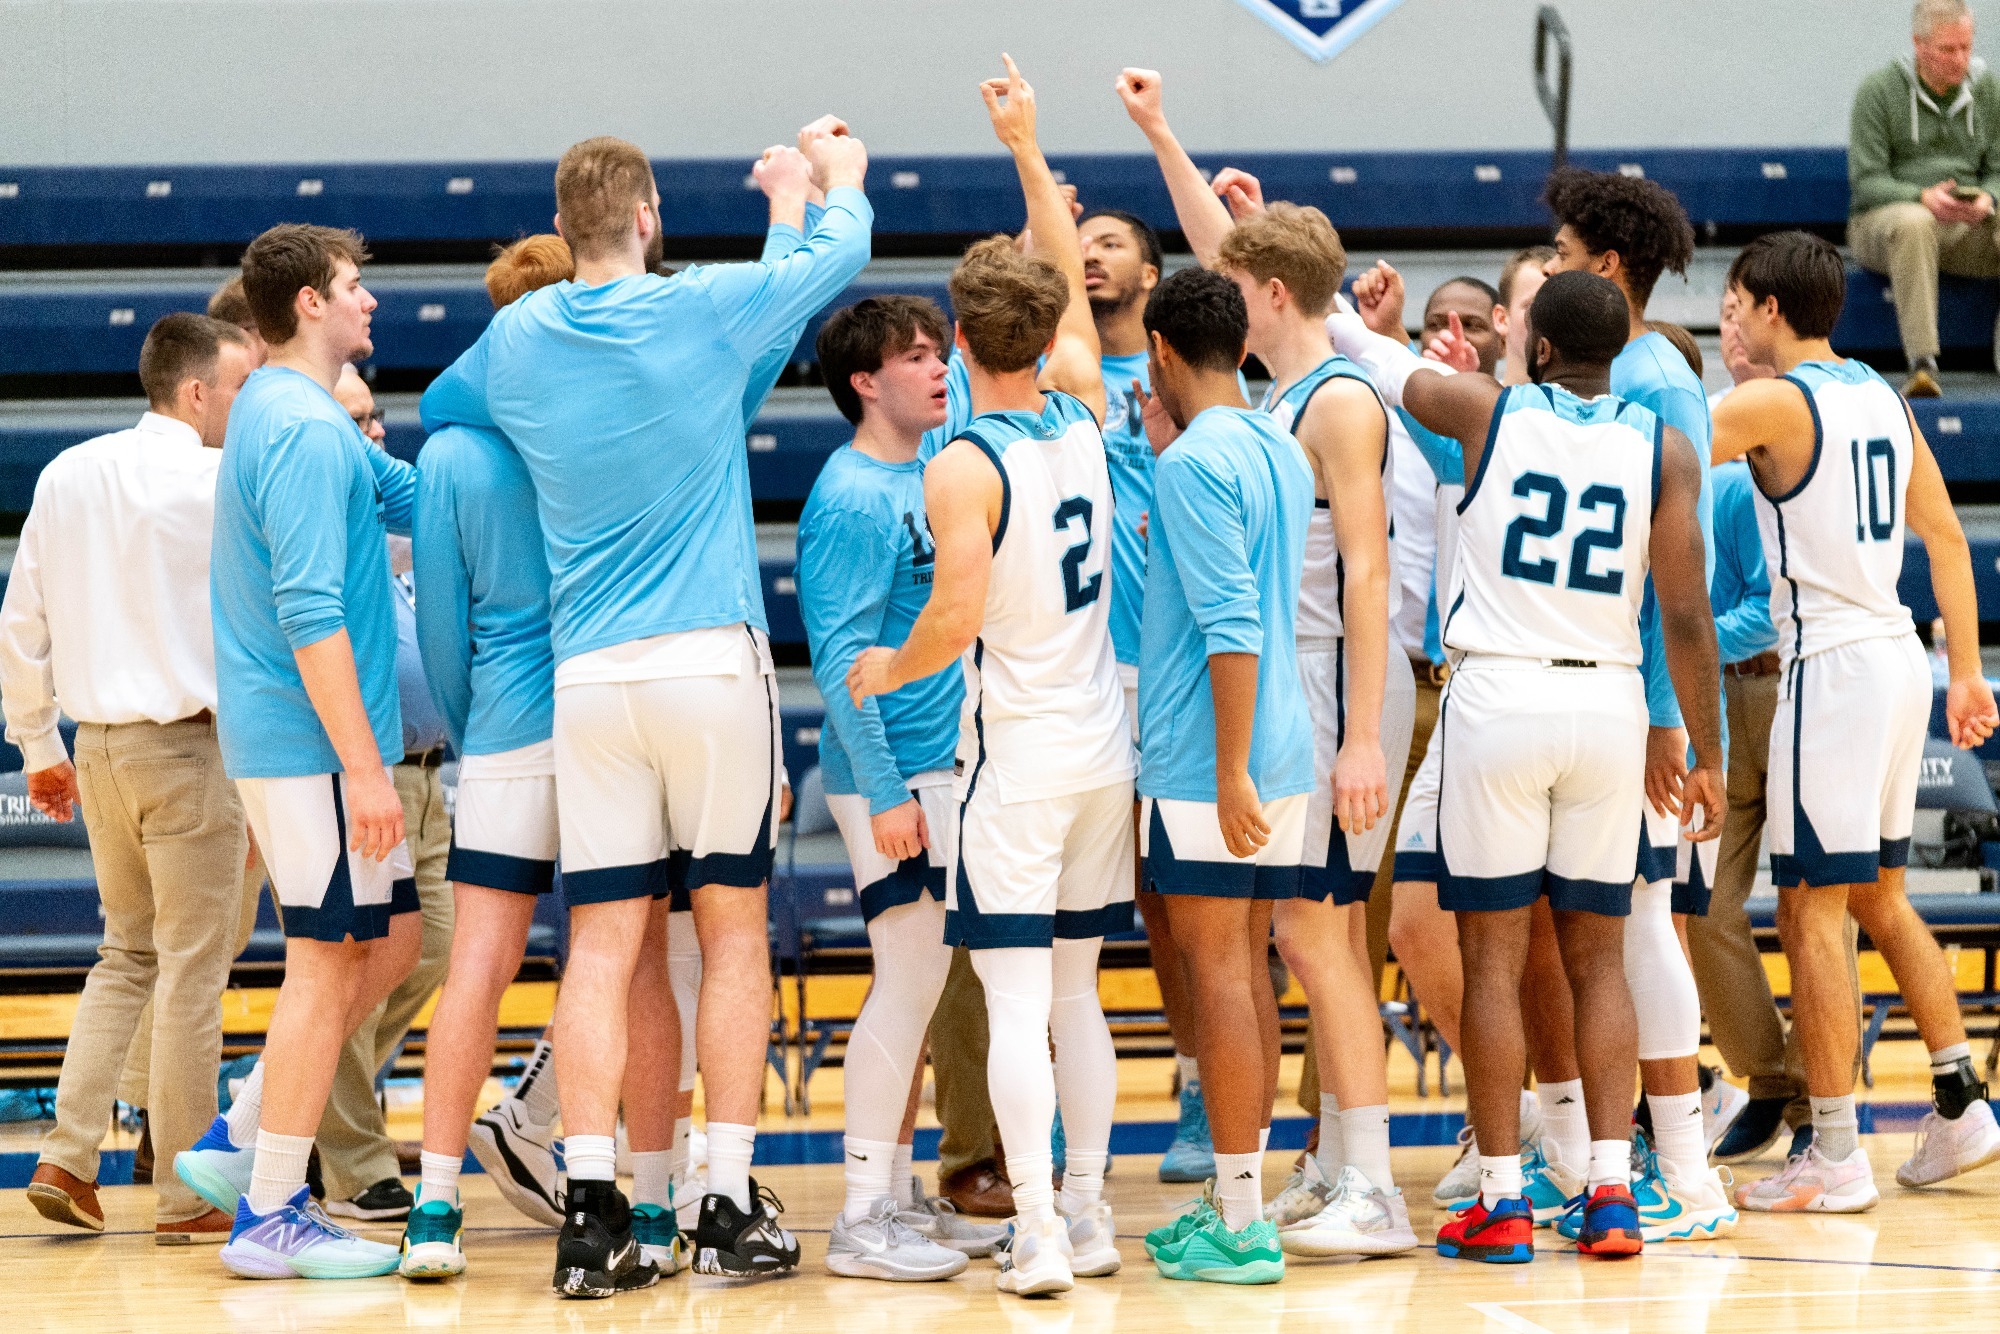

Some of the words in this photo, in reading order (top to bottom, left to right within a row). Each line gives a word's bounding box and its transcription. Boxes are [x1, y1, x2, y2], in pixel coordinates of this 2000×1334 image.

[1500, 469, 1629, 596] 22
[1851, 437, 1896, 543] 10
[912, 571, 934, 585] TRI
[1051, 494, 1104, 615] 2
